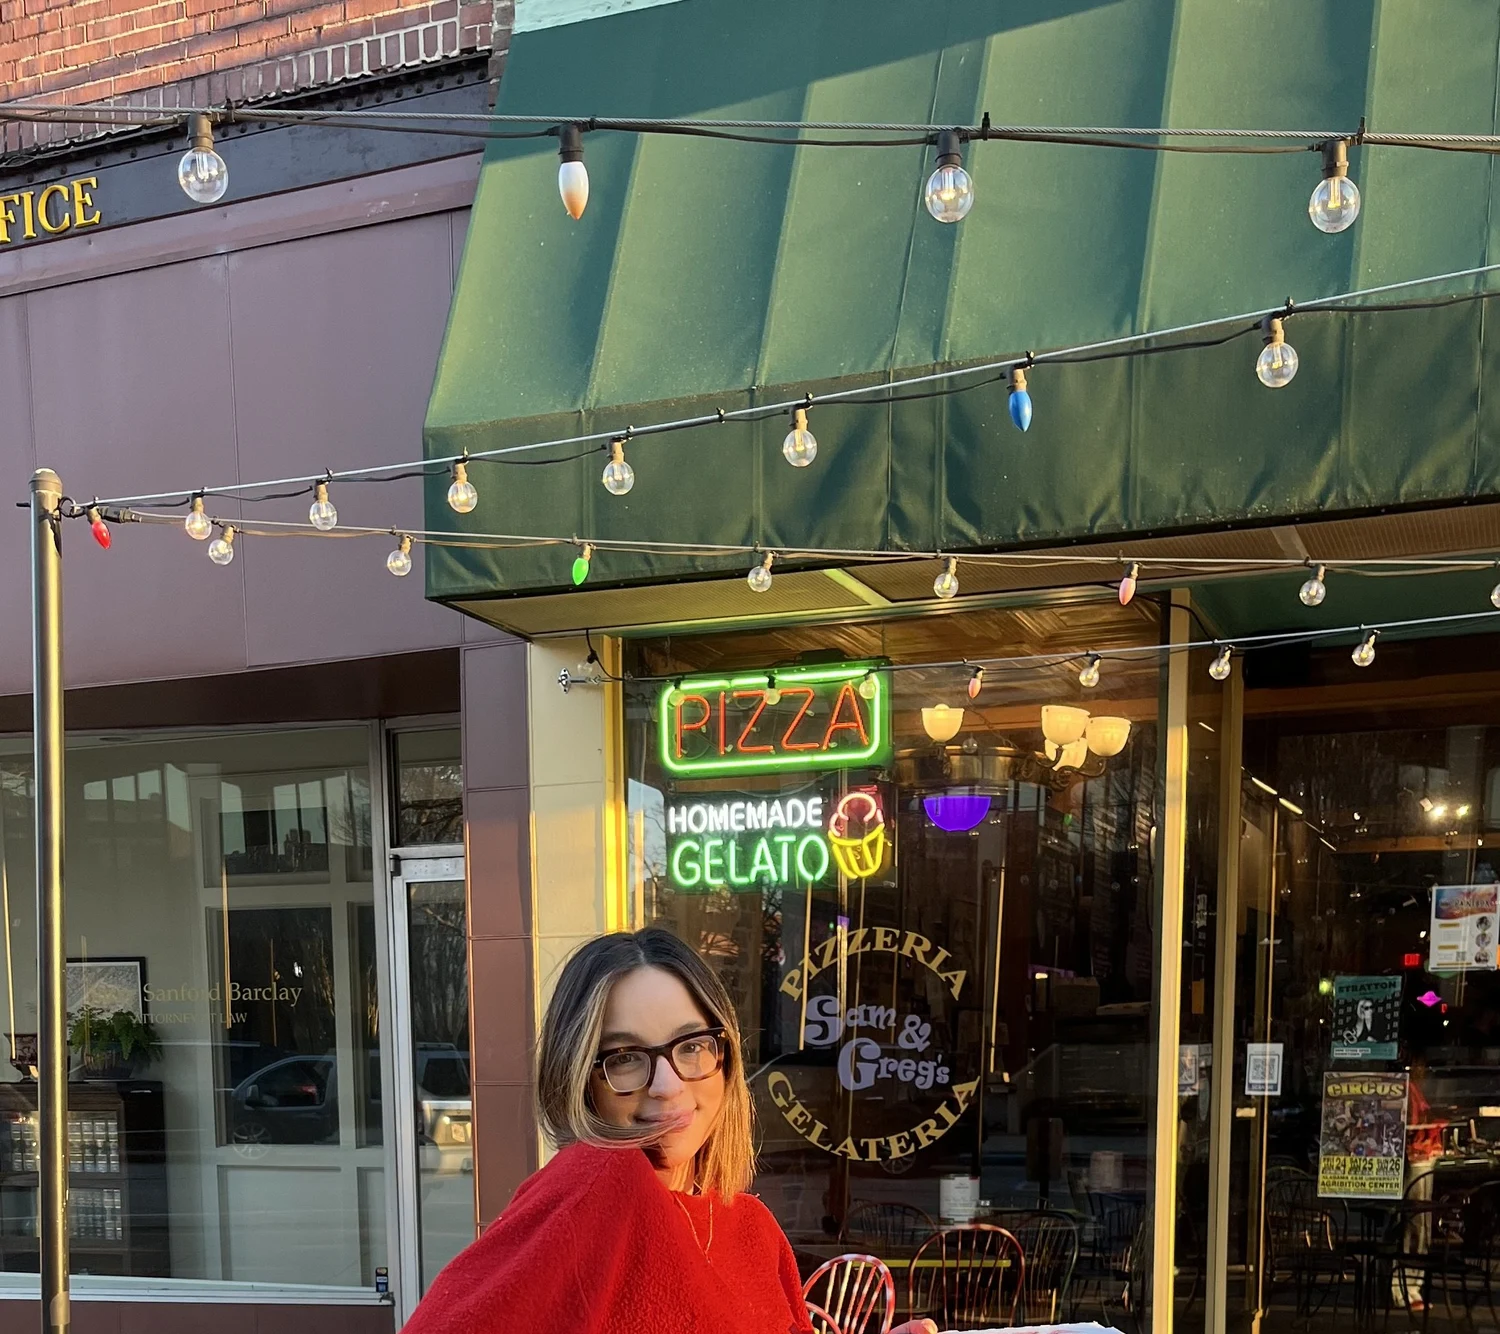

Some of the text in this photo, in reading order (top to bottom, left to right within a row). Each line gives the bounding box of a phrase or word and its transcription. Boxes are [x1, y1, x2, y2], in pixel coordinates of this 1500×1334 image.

[0, 177, 101, 243] FICE
[674, 683, 870, 759] PIZZA
[668, 796, 823, 835] HOMEMADE
[672, 834, 830, 886] GELATO
[778, 926, 968, 1001] PIZZERIA
[1338, 981, 1397, 993] STRATTON
[143, 982, 221, 1002] Sanford
[230, 982, 303, 1007] Barclay
[803, 995, 932, 1052] Sam &
[838, 1037, 950, 1090] Greg's
[1327, 1081, 1404, 1097] CIRCUS
[768, 1071, 981, 1162] GELATERIA
[1320, 1180, 1400, 1189] AGRIBITION CENTER
[1335, 1157, 1347, 1170] 24
[1361, 1157, 1374, 1171] 25
[1389, 1158, 1401, 1171] 26
